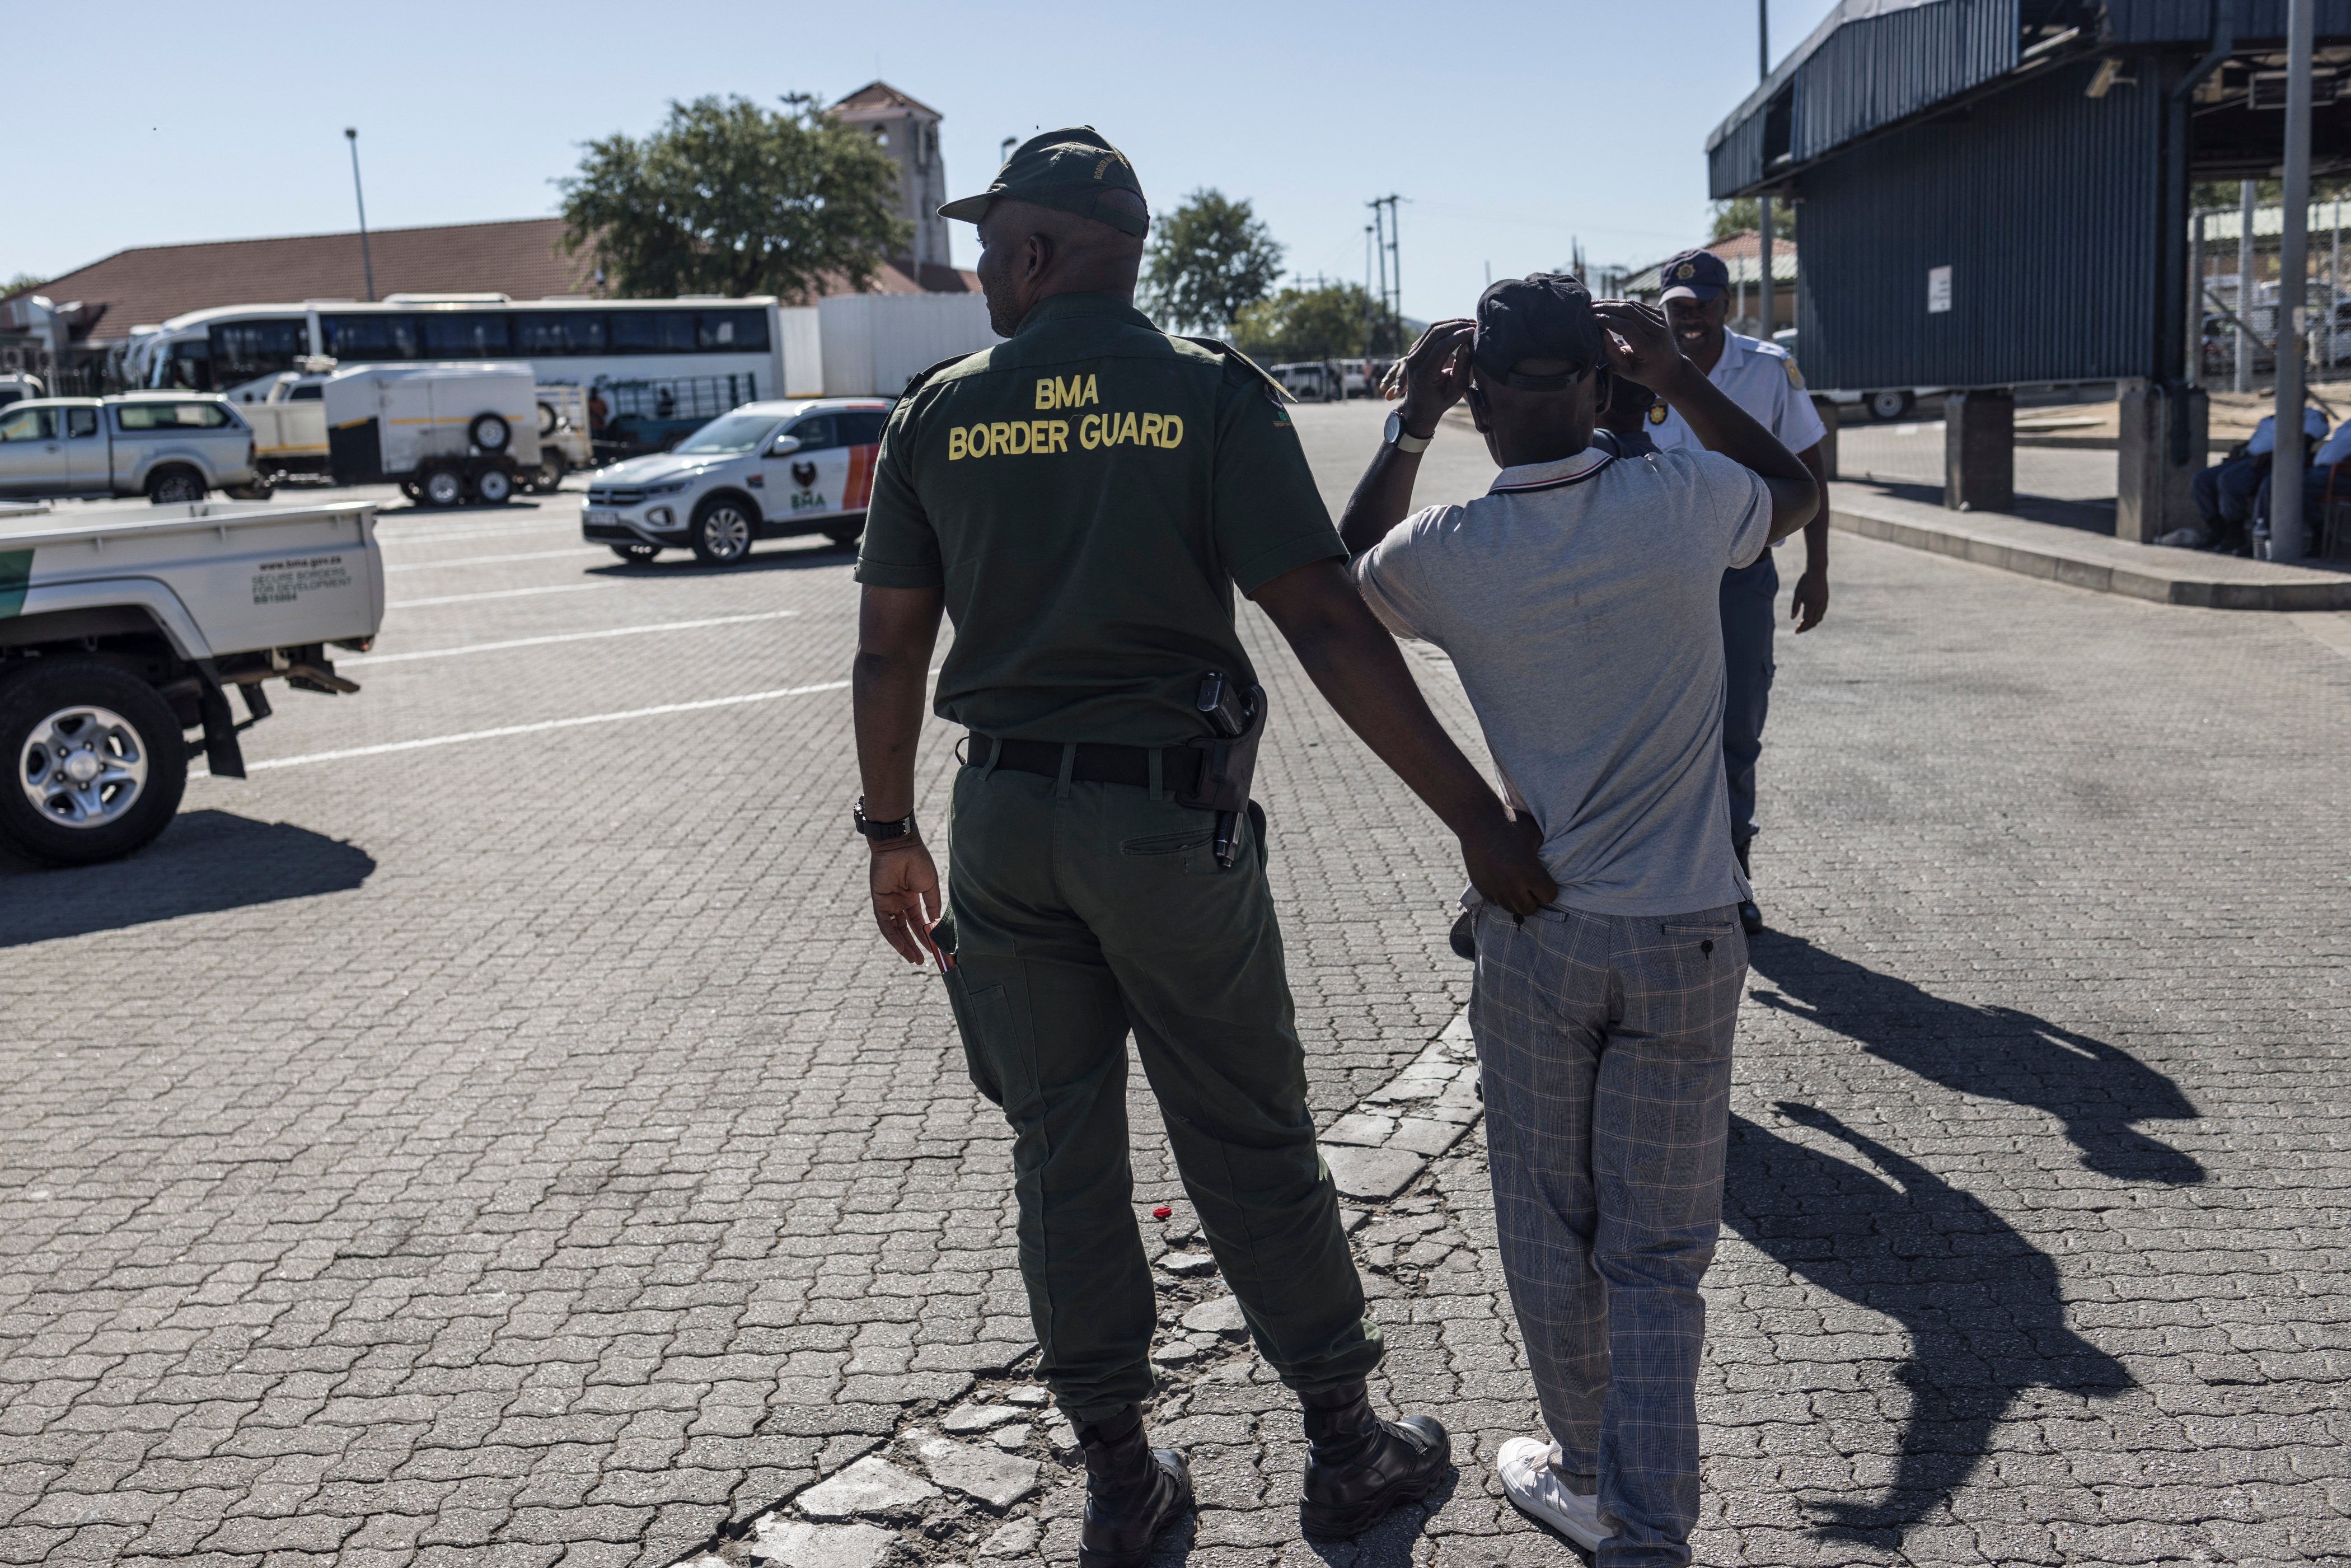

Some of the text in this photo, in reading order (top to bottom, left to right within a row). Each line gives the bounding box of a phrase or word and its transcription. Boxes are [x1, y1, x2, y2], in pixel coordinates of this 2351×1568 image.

[1094, 160, 1109, 179] BORDER
[1035, 374, 1099, 410] BMA
[949, 412, 1183, 461] BORDER GUARD
[791, 494, 826, 509] BMA
[259, 556, 341, 571] www.bma.gov.za
[252, 567, 345, 584] SECURE BORDERS
[252, 575, 351, 594] FOR DEVELOPMENT
